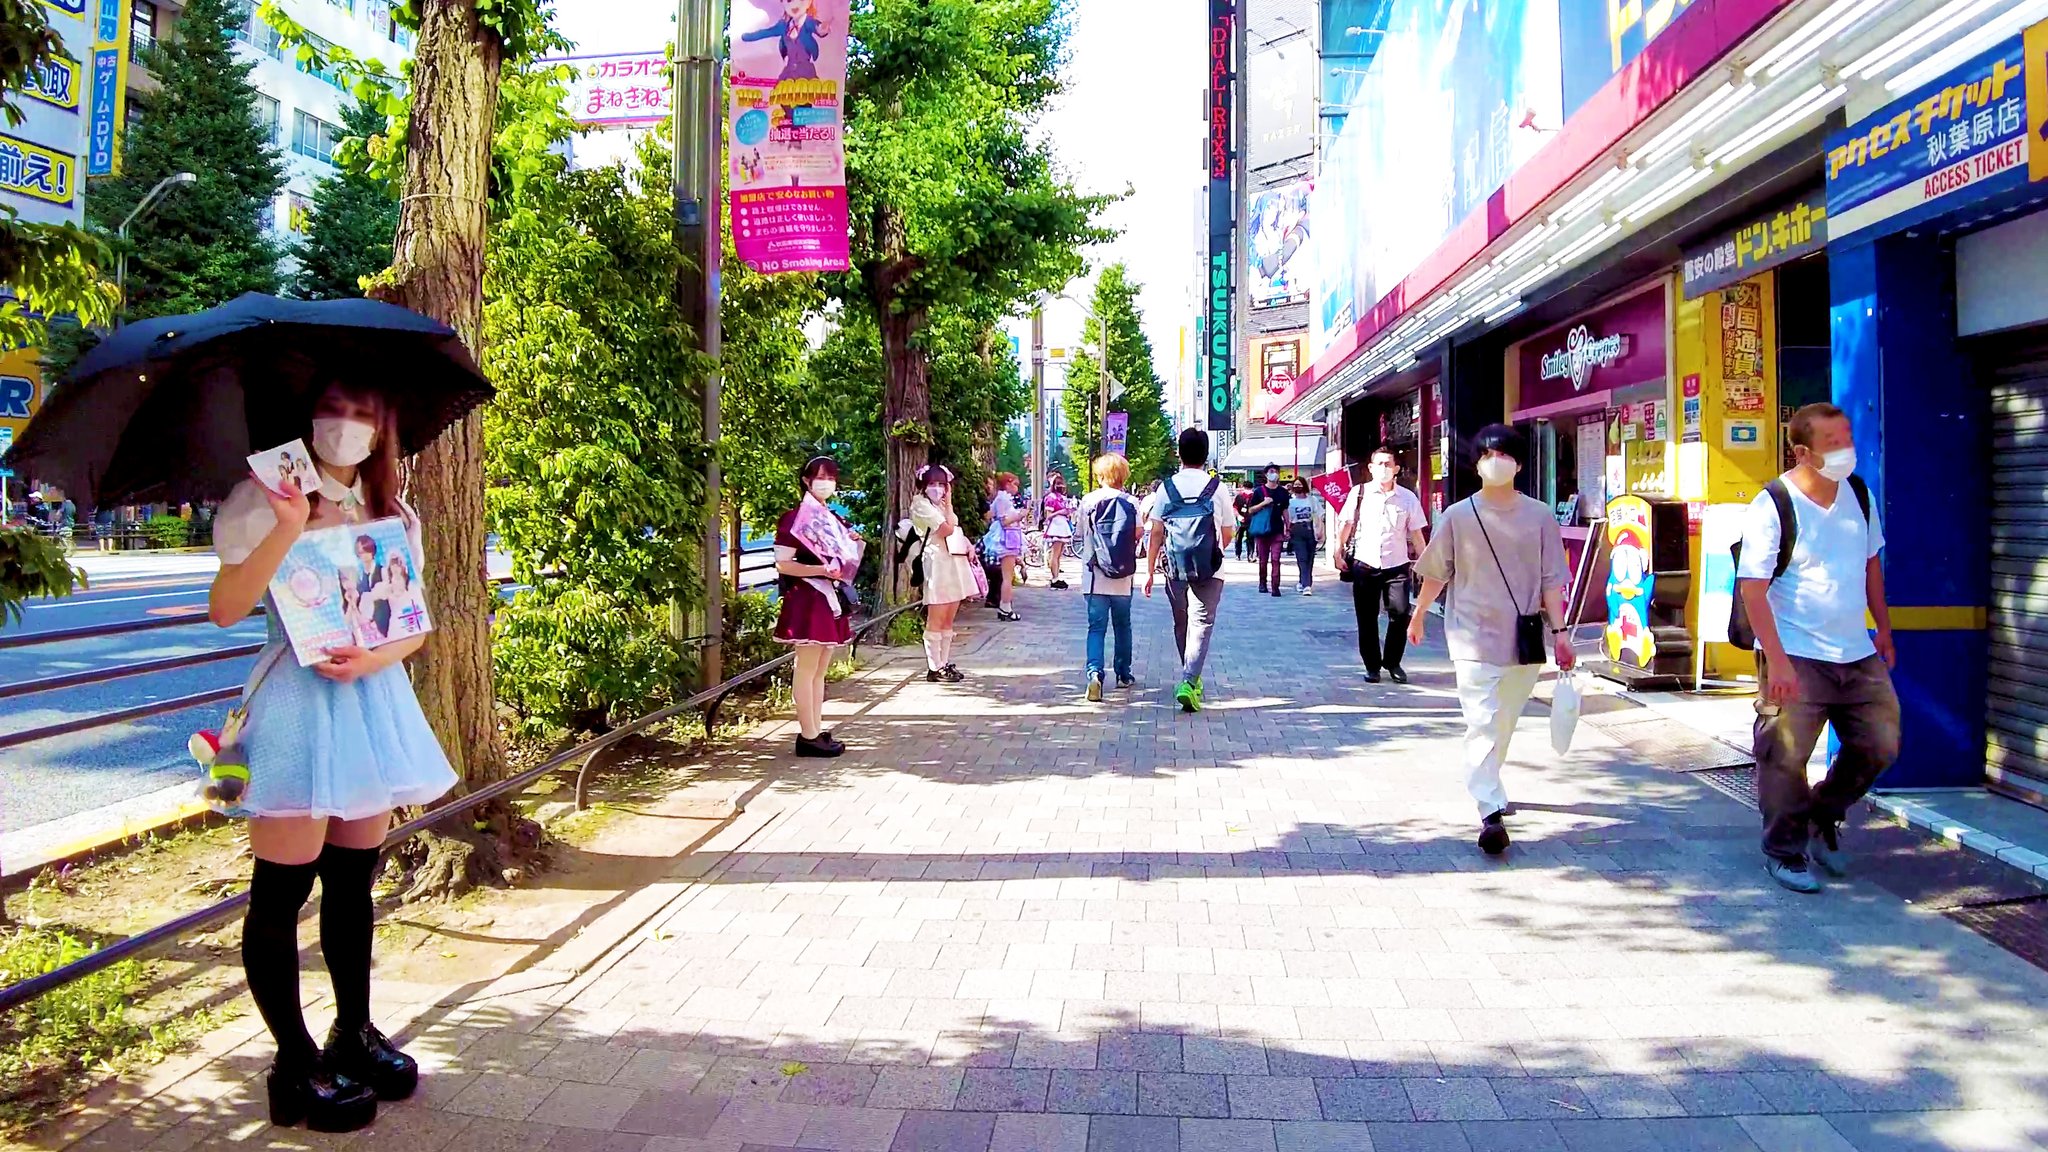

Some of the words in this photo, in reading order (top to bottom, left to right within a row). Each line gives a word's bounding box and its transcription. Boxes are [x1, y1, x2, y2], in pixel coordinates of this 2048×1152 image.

[601, 59, 668, 77] カラオケ
[1828, 58, 2021, 180] アクセスチケット
[1926, 97, 2020, 167] 秋葉原店
[1924, 164, 1971, 199] ACCESS
[1974, 138, 2023, 178] TICKET
[762, 260, 779, 271] NO
[782, 257, 823, 270] Smoking
[823, 257, 845, 267] Area
[1212, 252, 1227, 412] TSUKUMO
[1733, 283, 1759, 377] 外国通貨
[1541, 349, 1570, 380] Smiley
